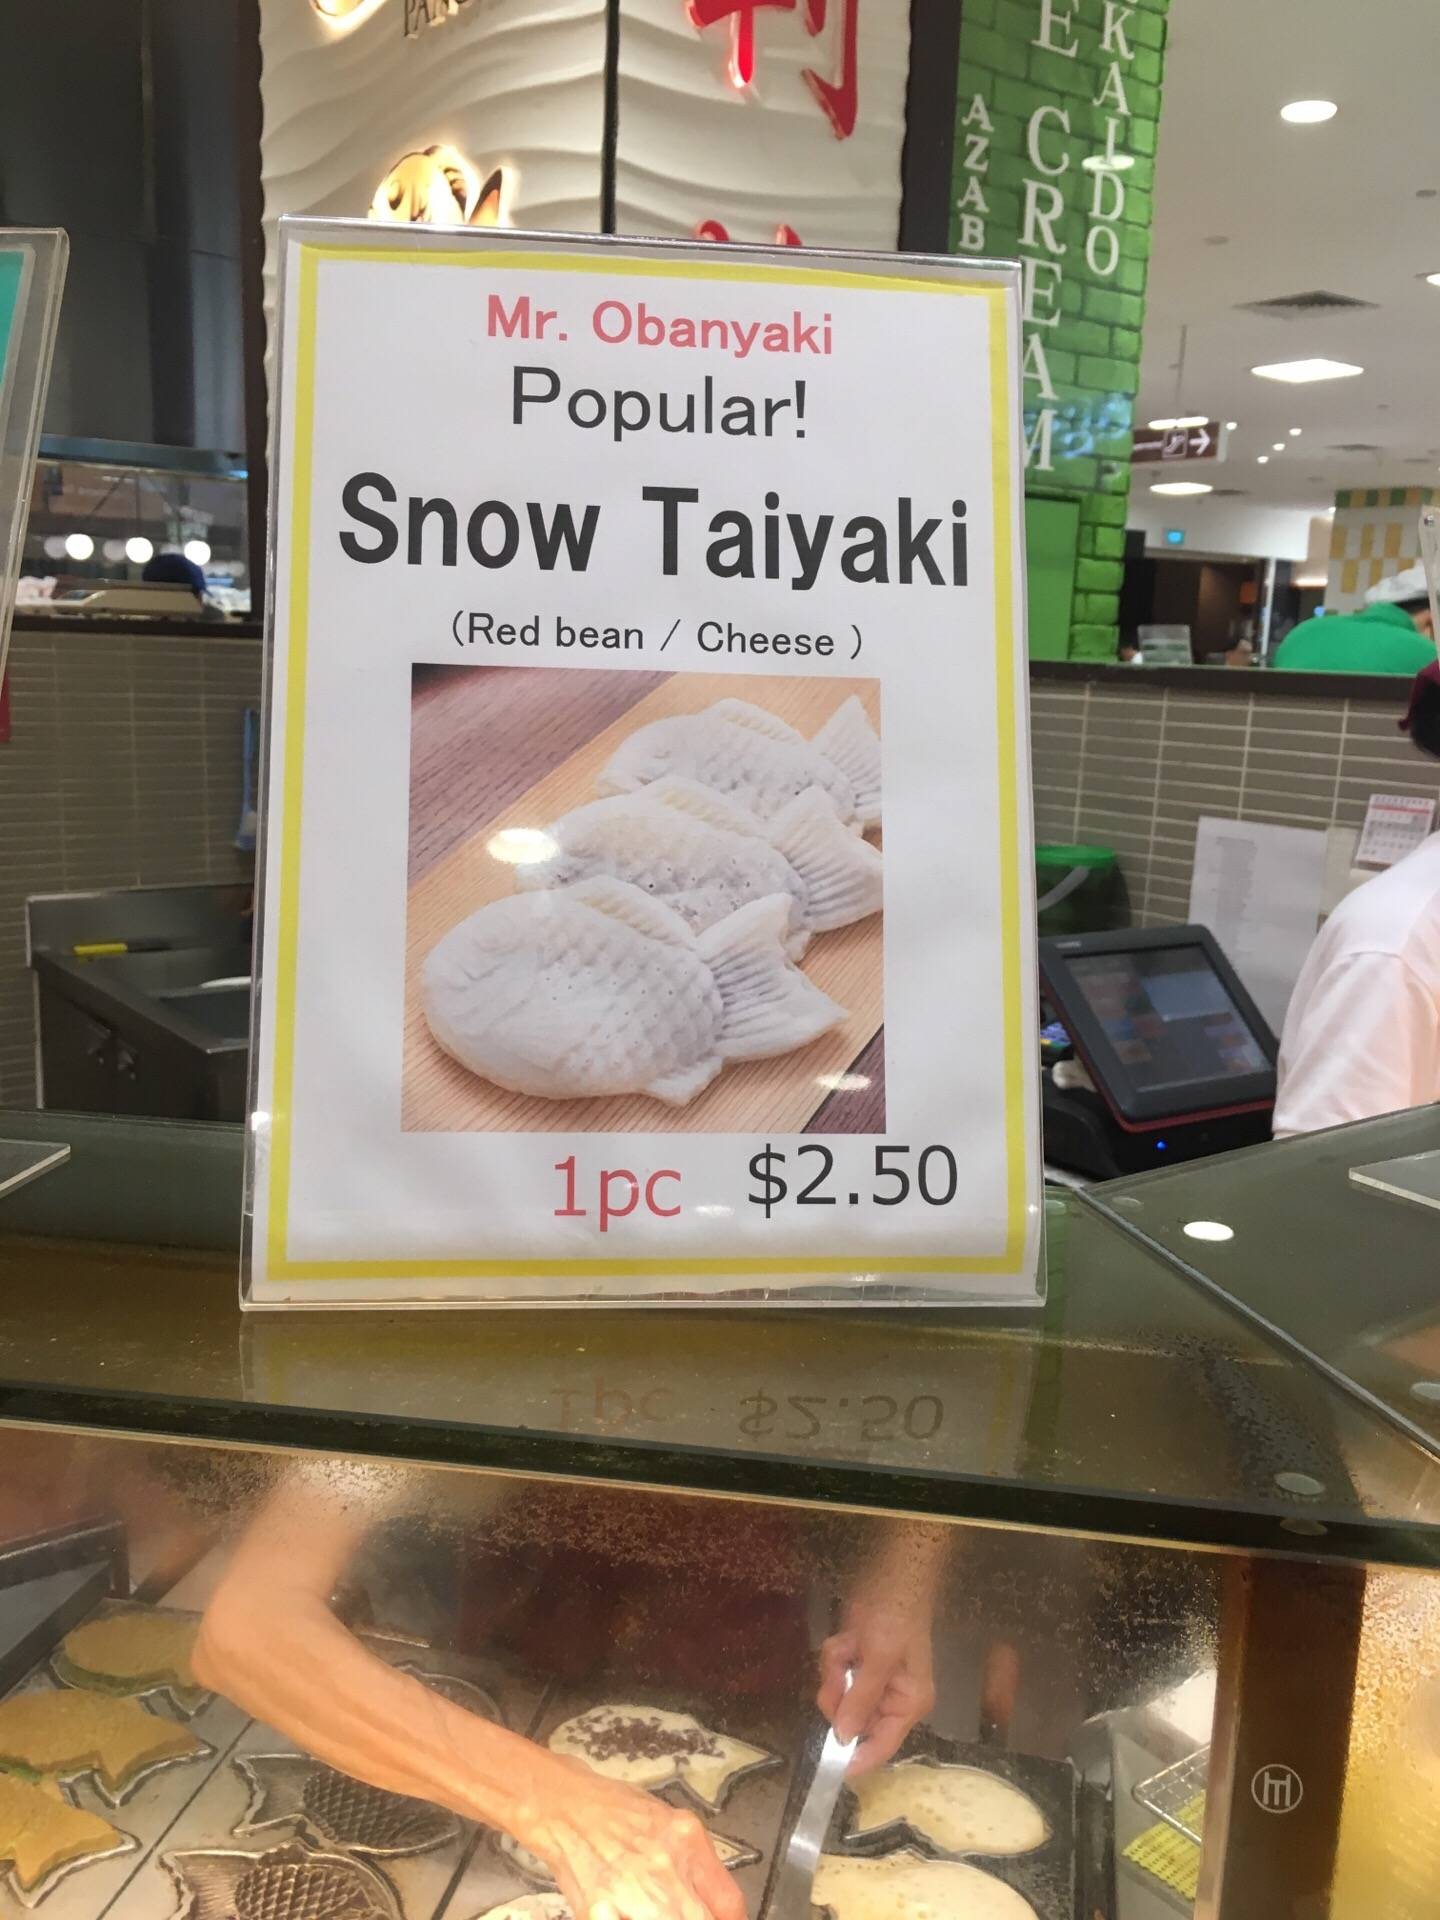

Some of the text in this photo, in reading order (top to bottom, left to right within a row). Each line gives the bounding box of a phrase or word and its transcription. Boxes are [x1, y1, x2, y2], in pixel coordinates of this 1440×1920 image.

[1086, 0, 1139, 277] KAIDO
[487, 294, 833, 359] Mr. Obanyaki
[1018, 105, 1071, 472] CREAM
[512, 365, 806, 443] Popular!
[338, 471, 968, 591] Snow Taiyaki
[452, 609, 540, 647] (Red
[556, 615, 644, 650] bean
[697, 621, 836, 656] Cheese
[554, 1142, 958, 1233] 1pc $2.50
